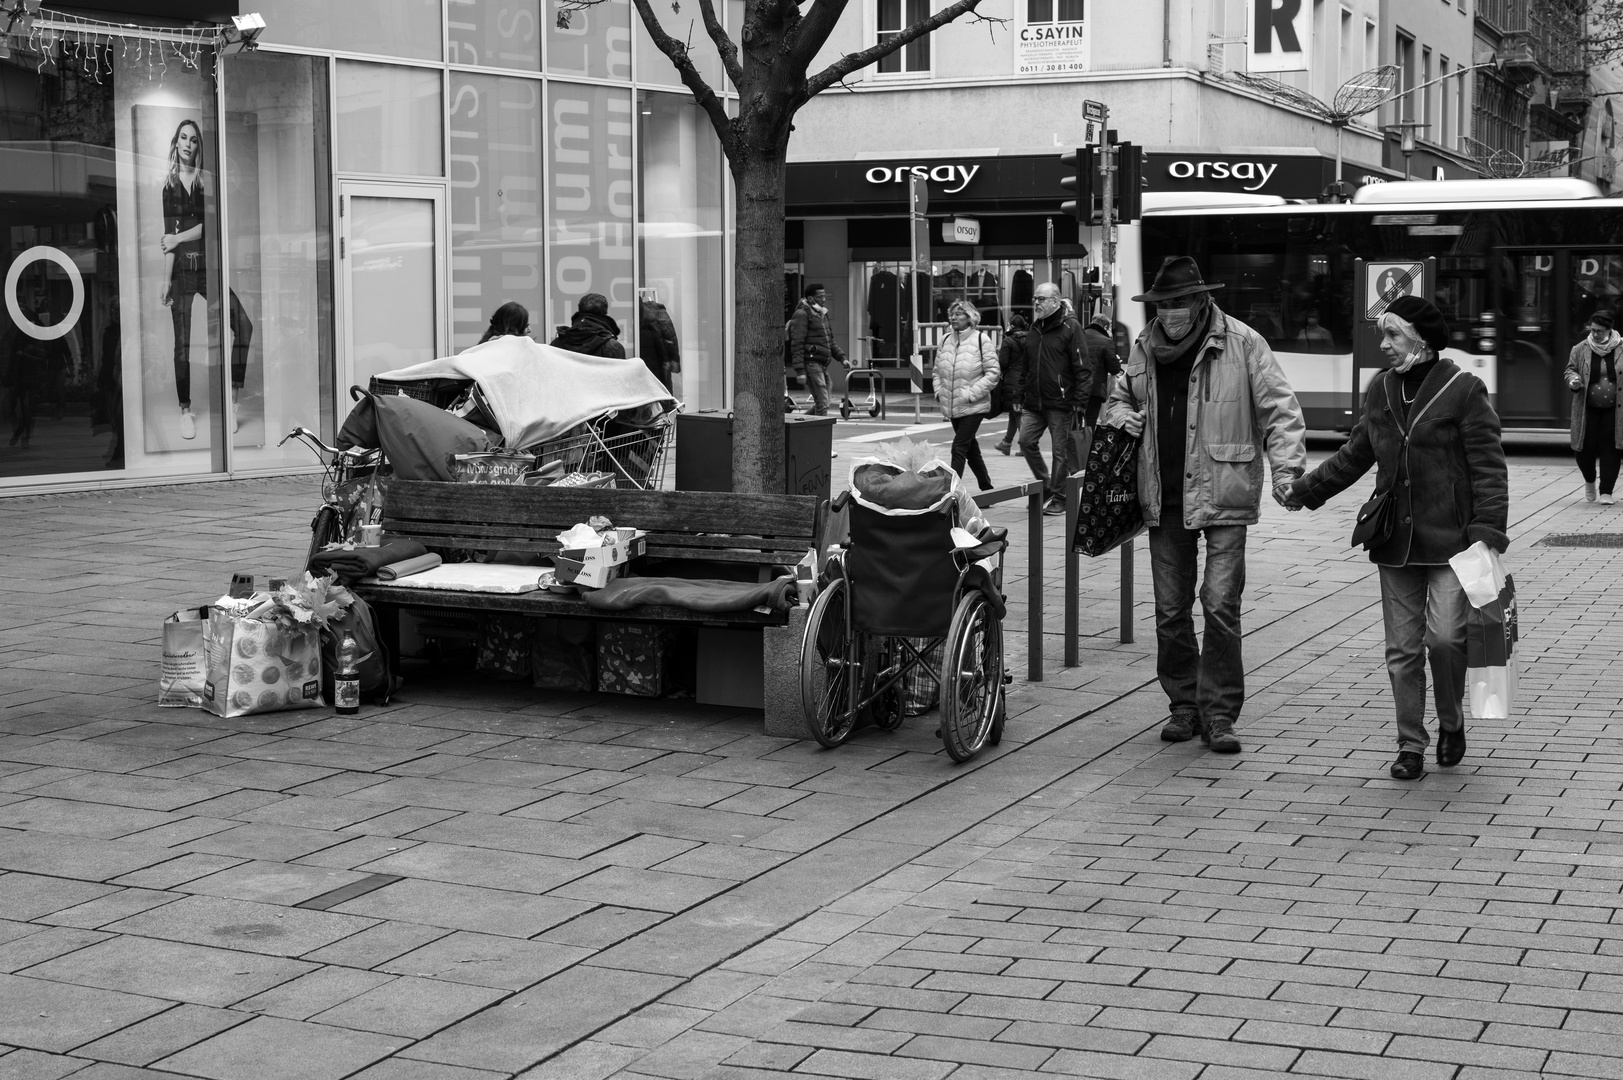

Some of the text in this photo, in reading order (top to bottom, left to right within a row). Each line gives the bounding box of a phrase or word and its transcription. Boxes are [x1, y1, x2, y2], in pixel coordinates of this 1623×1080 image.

[1020, 26, 1083, 41] C.SAYIN
[1254, 0, 1301, 54] R
[1020, 39, 1083, 48] PHYSIOTHERAPEUT
[865, 164, 980, 193] orsay
[1168, 161, 1278, 191] orsay
[550, 98, 592, 325] Forum
[956, 225, 977, 241] orsay
